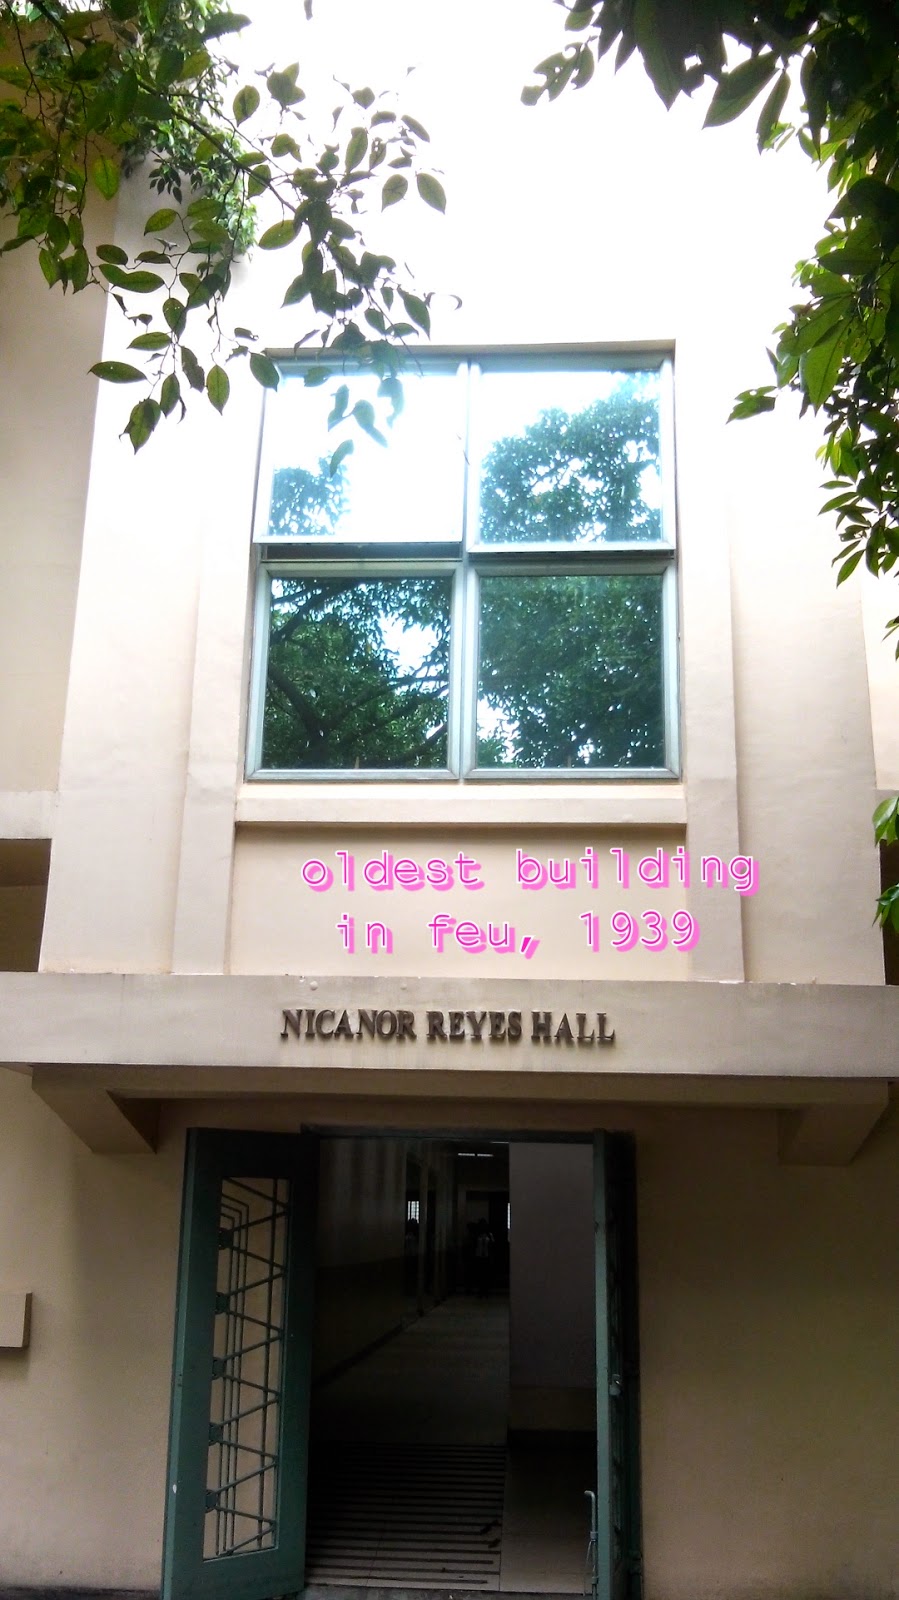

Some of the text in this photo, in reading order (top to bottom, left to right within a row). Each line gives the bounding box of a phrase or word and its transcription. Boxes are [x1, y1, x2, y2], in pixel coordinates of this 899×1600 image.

[280, 1008, 616, 1042] NICANOR REYES HALL
